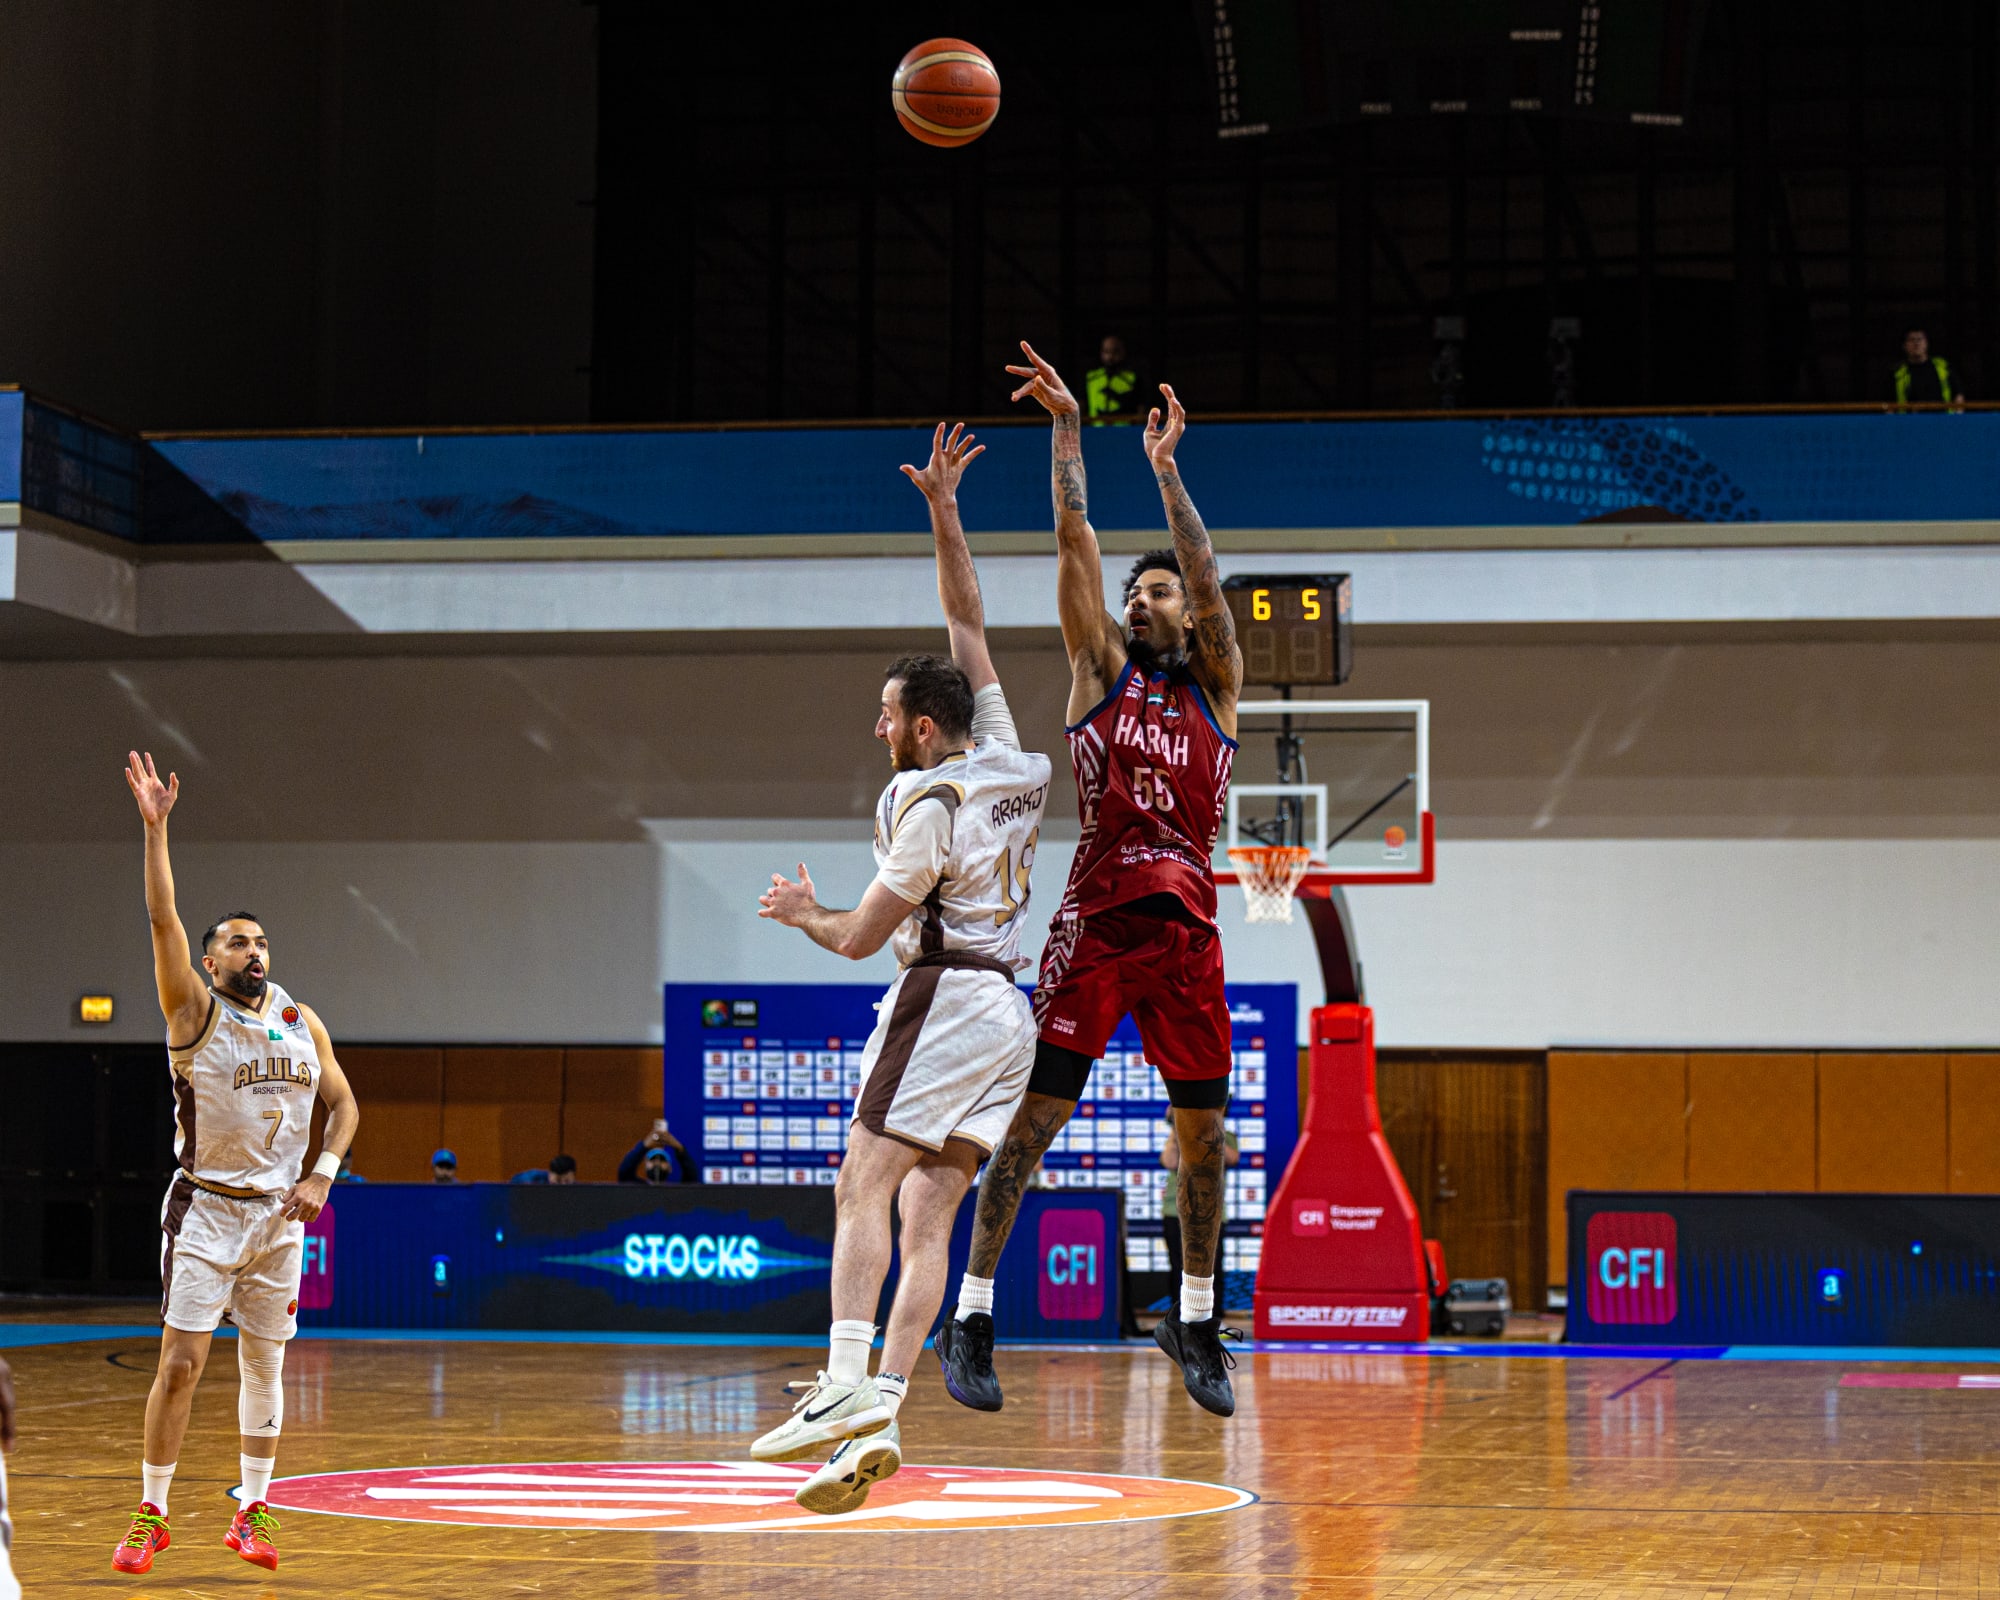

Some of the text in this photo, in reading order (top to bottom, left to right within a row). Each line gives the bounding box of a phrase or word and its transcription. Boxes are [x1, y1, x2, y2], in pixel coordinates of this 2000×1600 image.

[1252, 588, 1320, 620] 6 5
[1133, 767, 1175, 812] 55
[233, 1057, 312, 1090] ALULA
[252, 1085, 293, 1096] BASKETBALL
[262, 1109, 283, 1150] 7
[1299, 1211, 1324, 1226] CFI
[1330, 1205, 1384, 1218] Empower
[302, 1236, 327, 1275] FI
[624, 1234, 761, 1280] STOCKS
[1046, 1243, 1097, 1286] CFI
[1599, 1246, 1666, 1289] CFI
